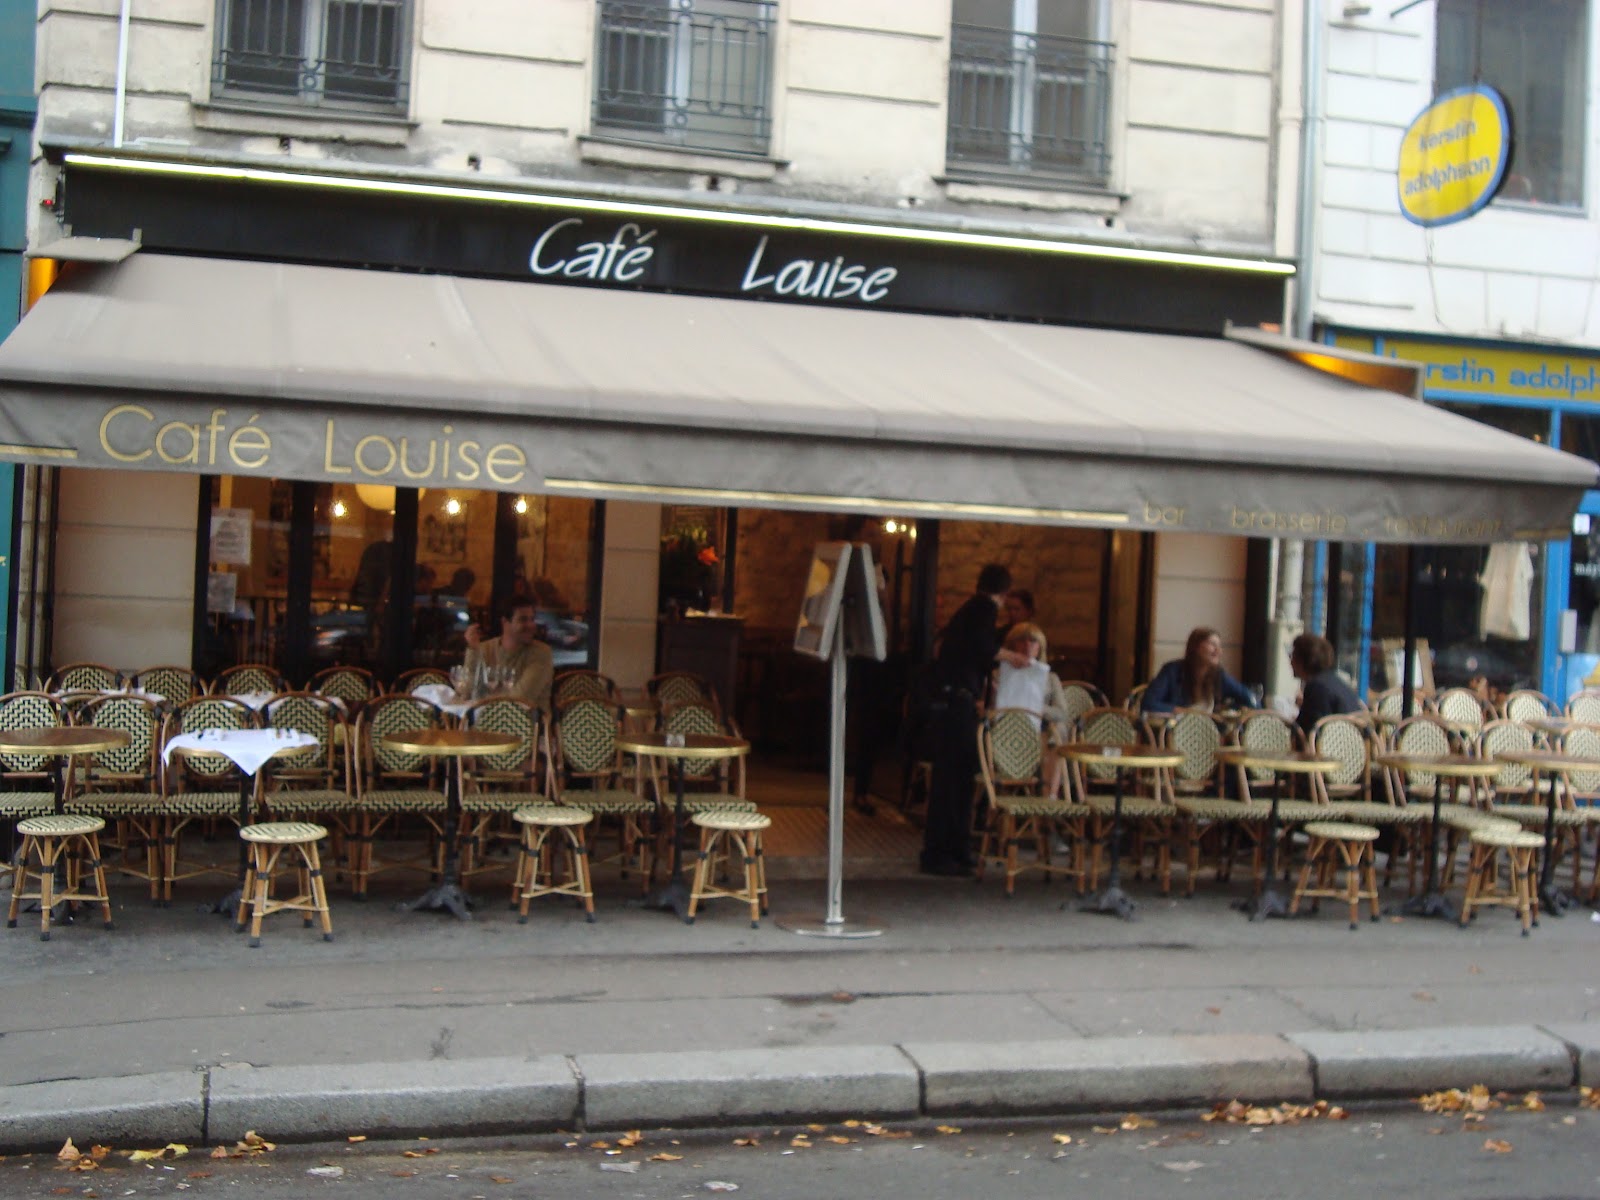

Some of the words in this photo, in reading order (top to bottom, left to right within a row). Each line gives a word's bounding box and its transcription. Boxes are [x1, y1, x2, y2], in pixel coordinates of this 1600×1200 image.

[1420, 119, 1476, 151] kerstin
[1405, 157, 1491, 195] adolphson
[529, 218, 656, 281] Café
[741, 235, 898, 302] Louise
[99, 404, 271, 470] Café
[324, 419, 527, 485] Louise
[1142, 502, 1184, 525] bar
[1231, 507, 1347, 535] brasserie
